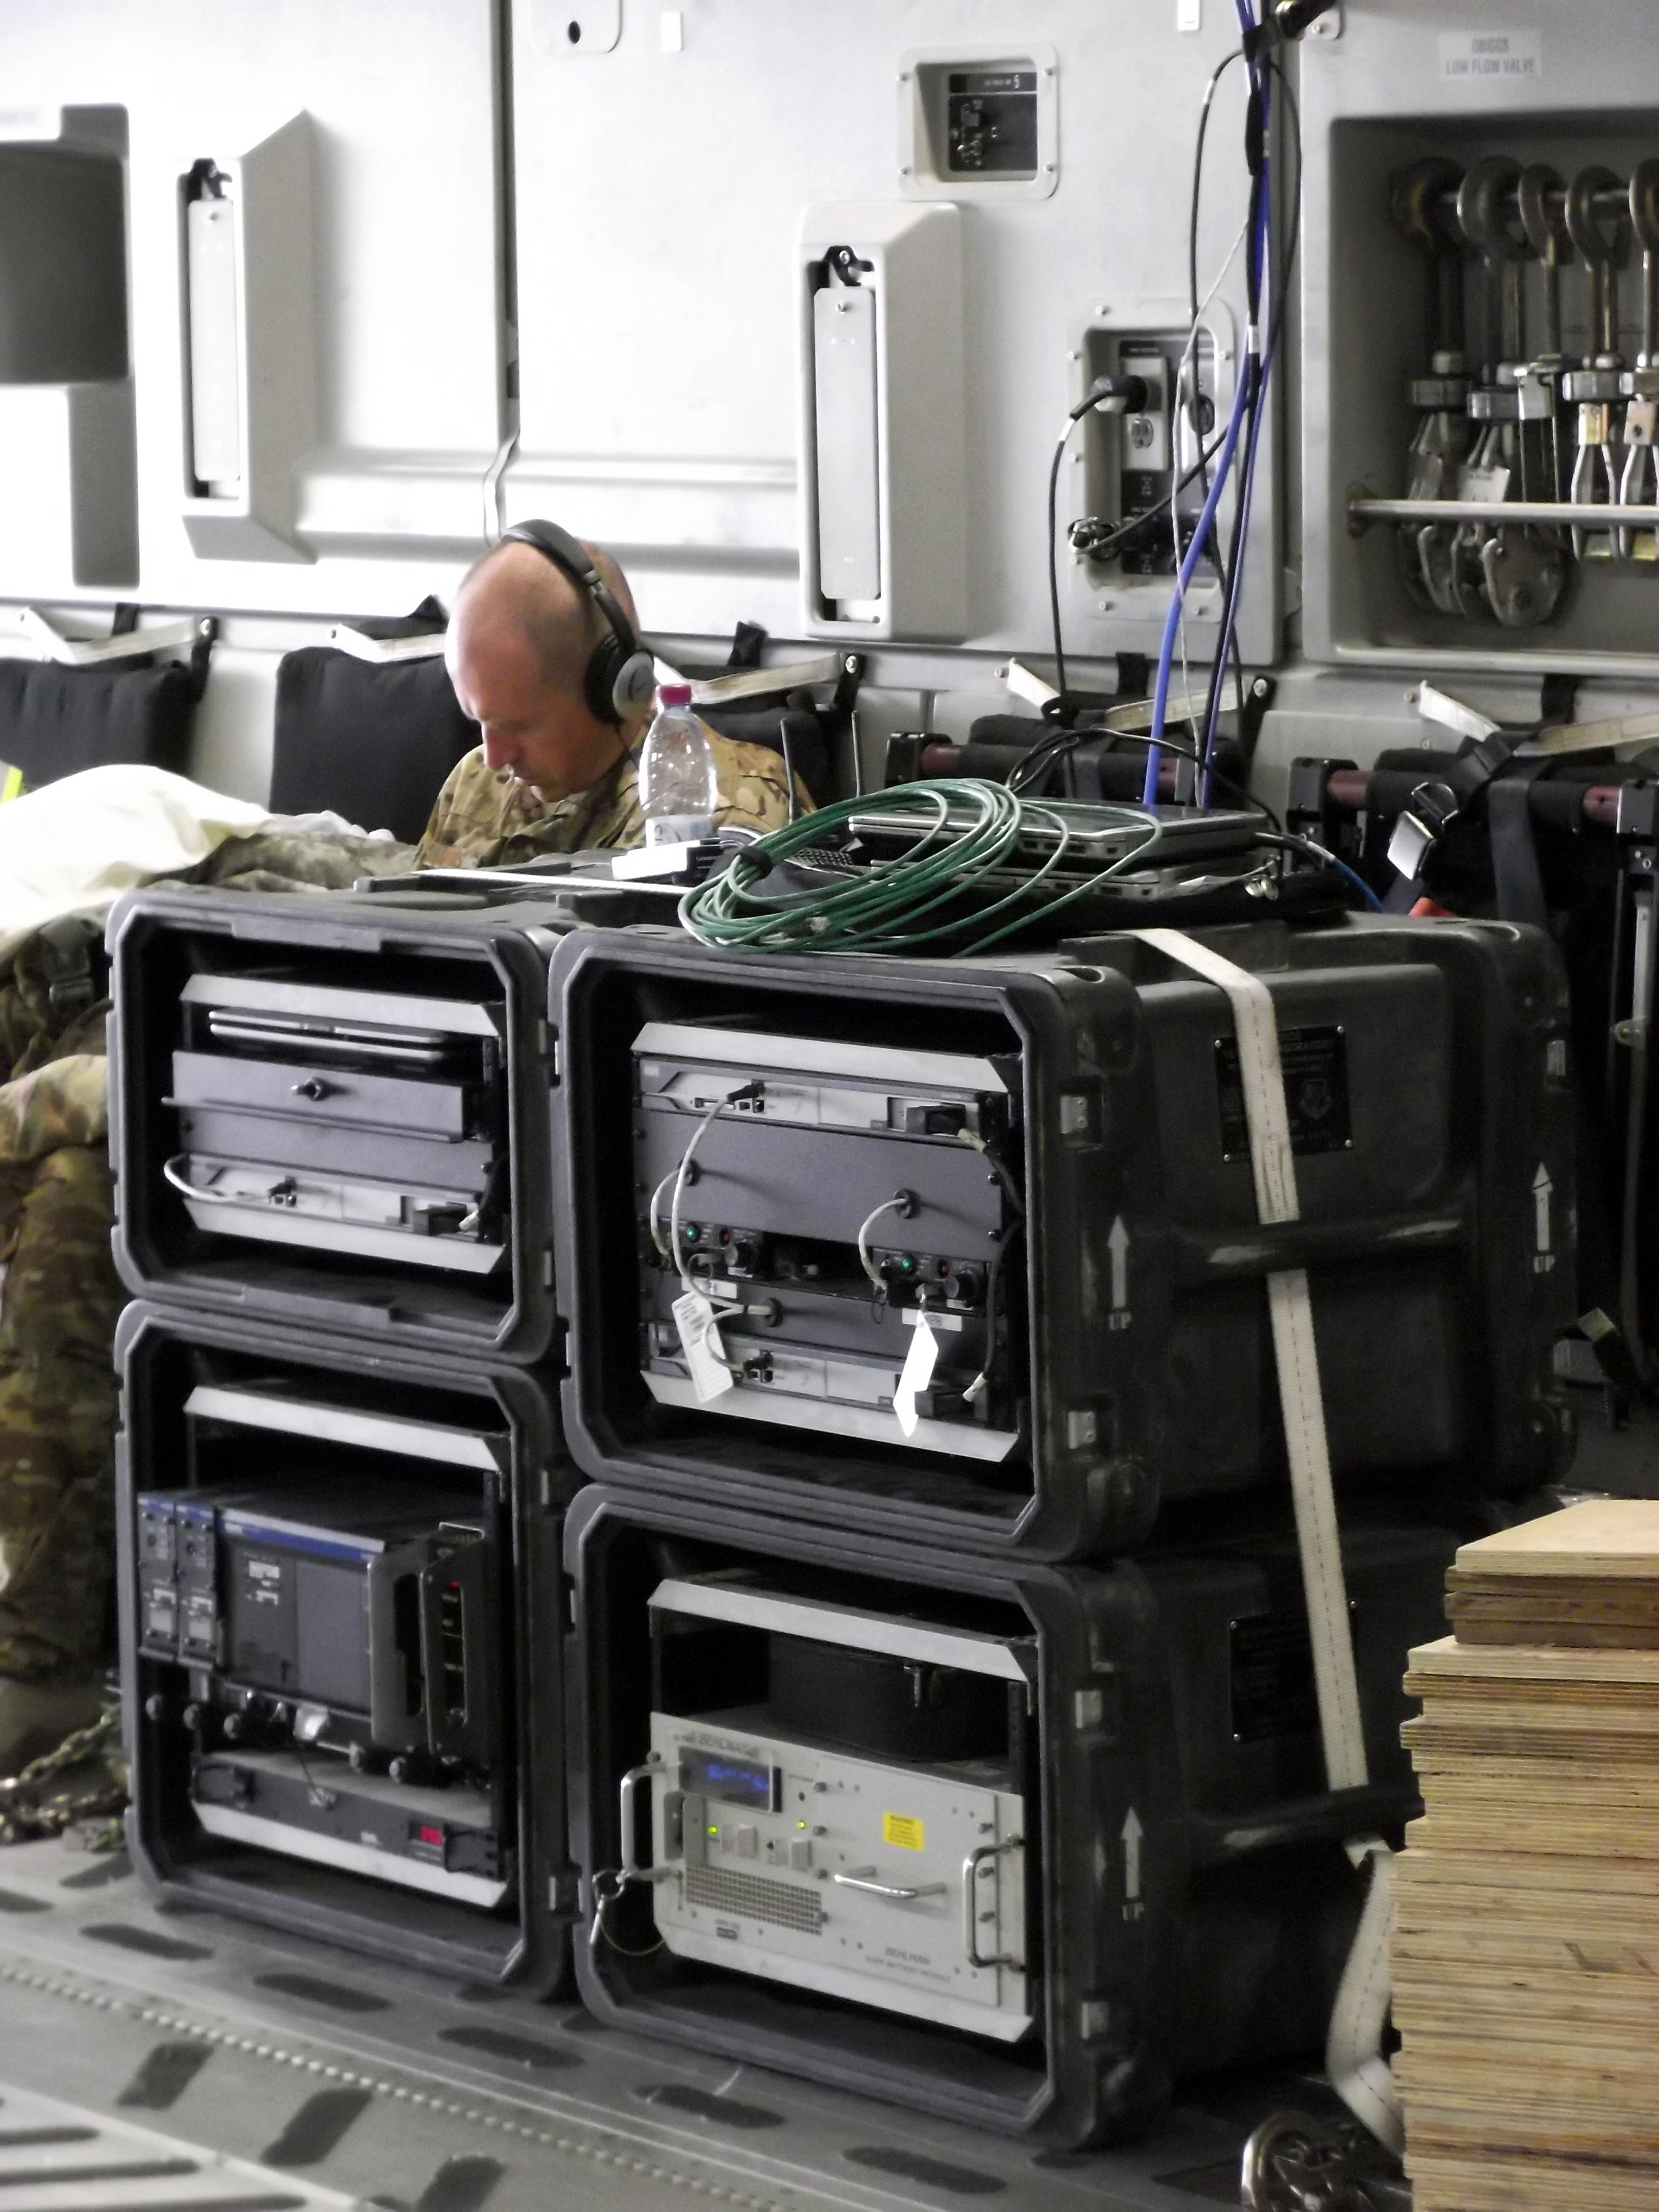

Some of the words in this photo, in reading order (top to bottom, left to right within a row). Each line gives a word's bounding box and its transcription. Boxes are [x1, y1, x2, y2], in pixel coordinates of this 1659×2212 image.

[1446, 58, 1469, 74] LOW
[1472, 58, 1500, 73] FLOW
[1503, 56, 1534, 73] VALVE
[1534, 1255, 1555, 1273] UP
[1109, 1312, 1131, 1330] UP
[1123, 1902, 1144, 1921] UP
